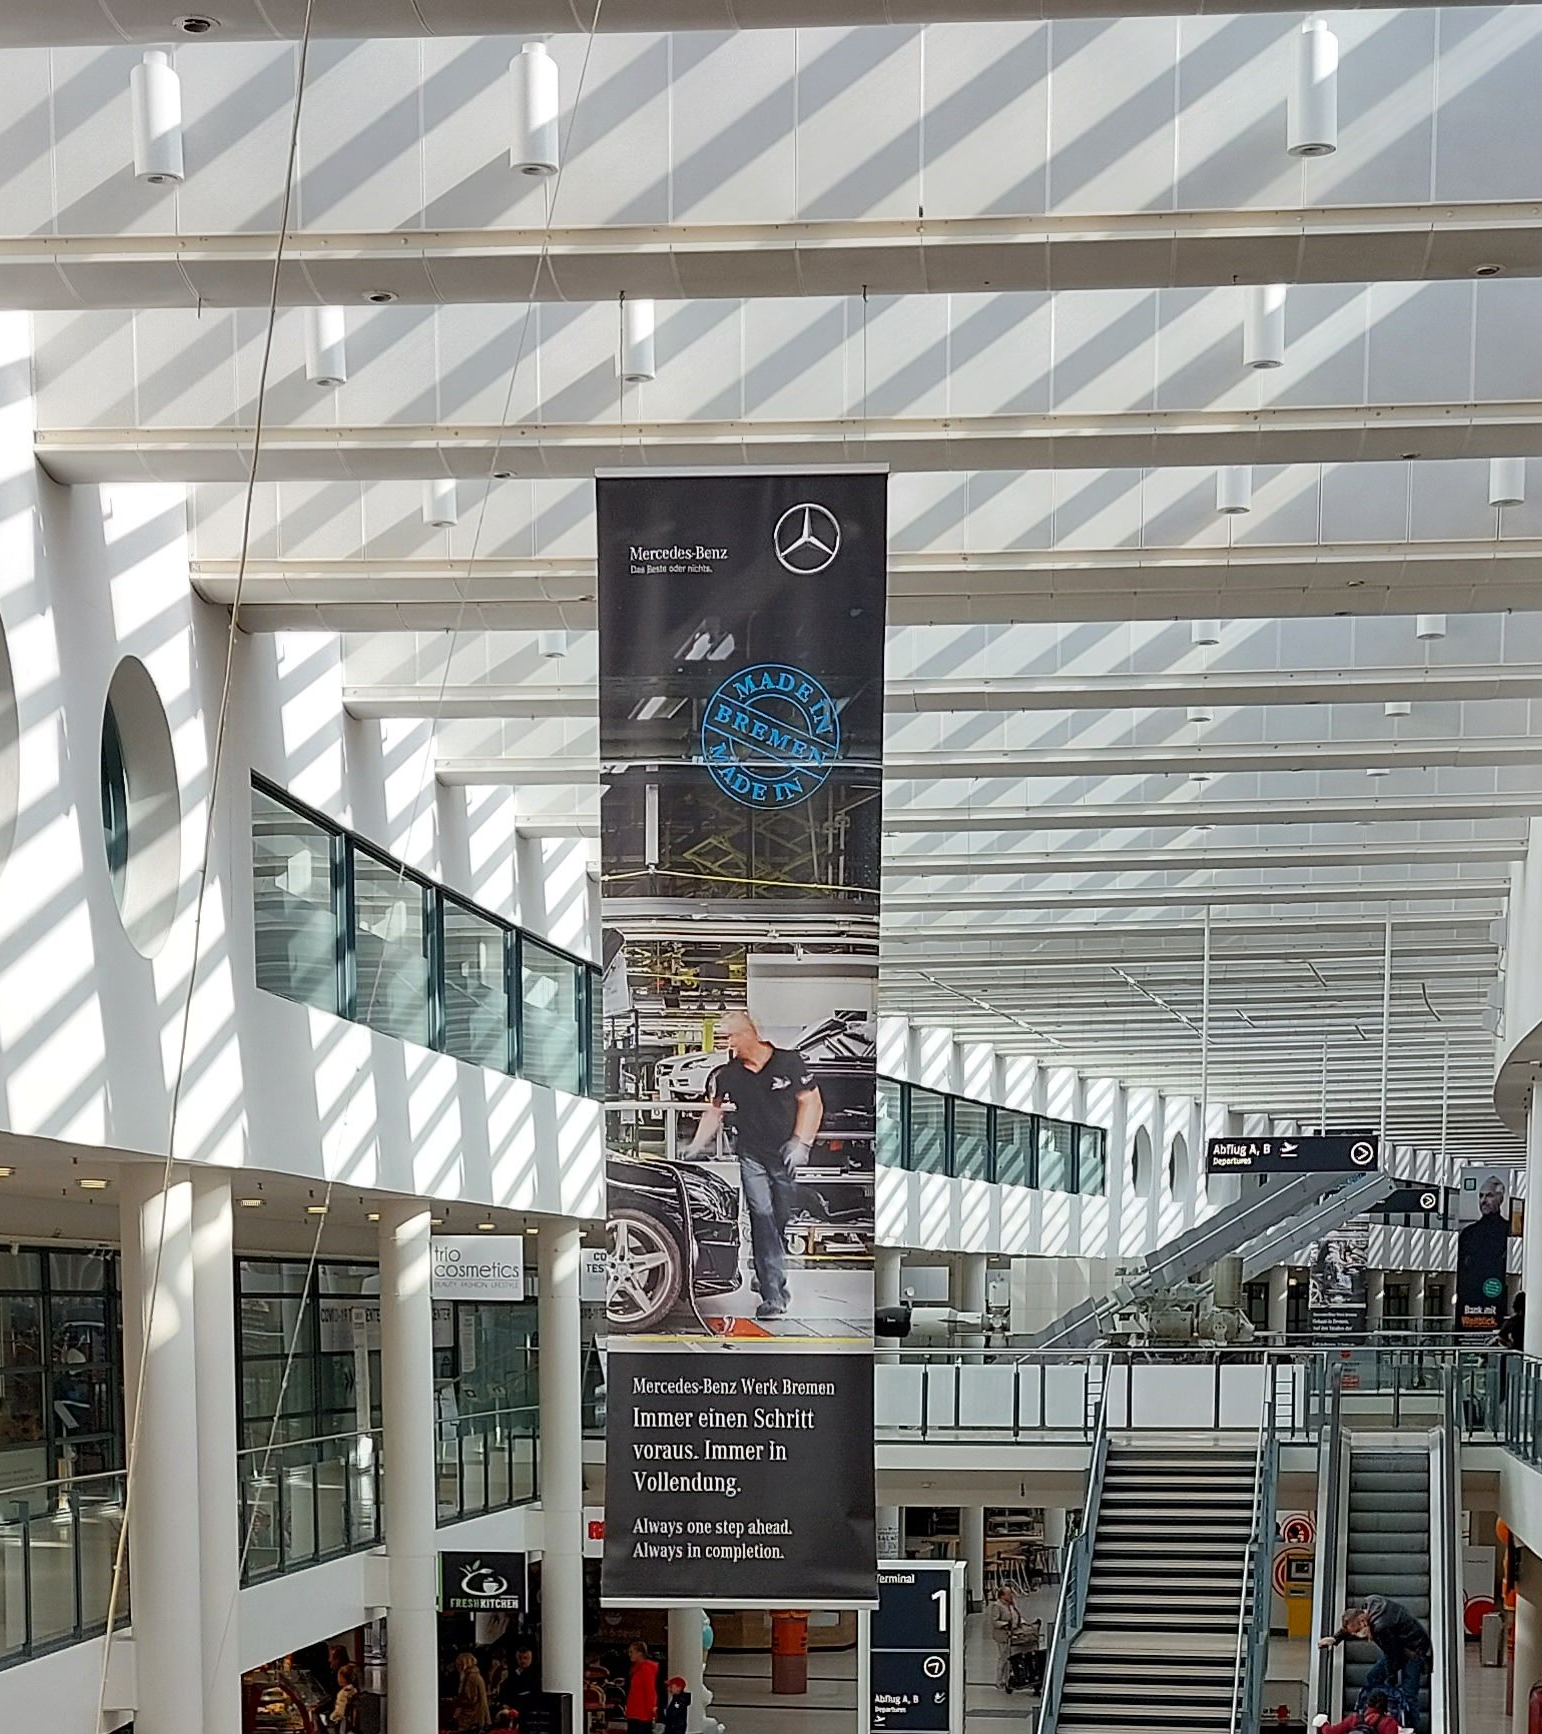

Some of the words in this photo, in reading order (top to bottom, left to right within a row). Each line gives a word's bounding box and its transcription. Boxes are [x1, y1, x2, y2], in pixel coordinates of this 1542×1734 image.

[629, 546, 729, 561] Mercedes-Benz
[668, 564, 687, 573] oder
[732, 672, 814, 703] MADE
[809, 698, 834, 734] IN
[714, 703, 829, 768] BREMEN
[708, 742, 768, 801] MADE
[773, 776, 803, 802] IN
[1213, 1143, 1247, 1157] Abflug
[1248, 1143, 1260, 1156] A,
[1263, 1143, 1271, 1154] B
[1213, 1157, 1252, 1166] Departures
[434, 1246, 461, 1262] trio
[434, 1262, 520, 1278] cosmetics
[632, 1375, 737, 1395] Mercedes-Benz
[741, 1378, 778, 1395] Werk
[782, 1378, 835, 1396] Bremen
[633, 1407, 693, 1428] Immer
[698, 1407, 748, 1428] einen
[753, 1407, 815, 1429] Schritt
[633, 1443, 700, 1460] voraus.
[704, 1440, 763, 1461] Immer
[769, 1440, 787, 1461] in
[633, 1471, 742, 1497] Vollendung.
[633, 1518, 683, 1538] Always
[687, 1521, 712, 1534] one
[715, 1520, 744, 1539] step
[748, 1519, 792, 1535] ahead.
[633, 1542, 682, 1561] Always
[687, 1542, 701, 1558] in
[705, 1542, 785, 1563] completion.
[876, 1574, 915, 1584] Terminal
[931, 1589, 947, 1631] 1
[874, 1694, 900, 1705] Abflug
[913, 1694, 919, 1703] B
